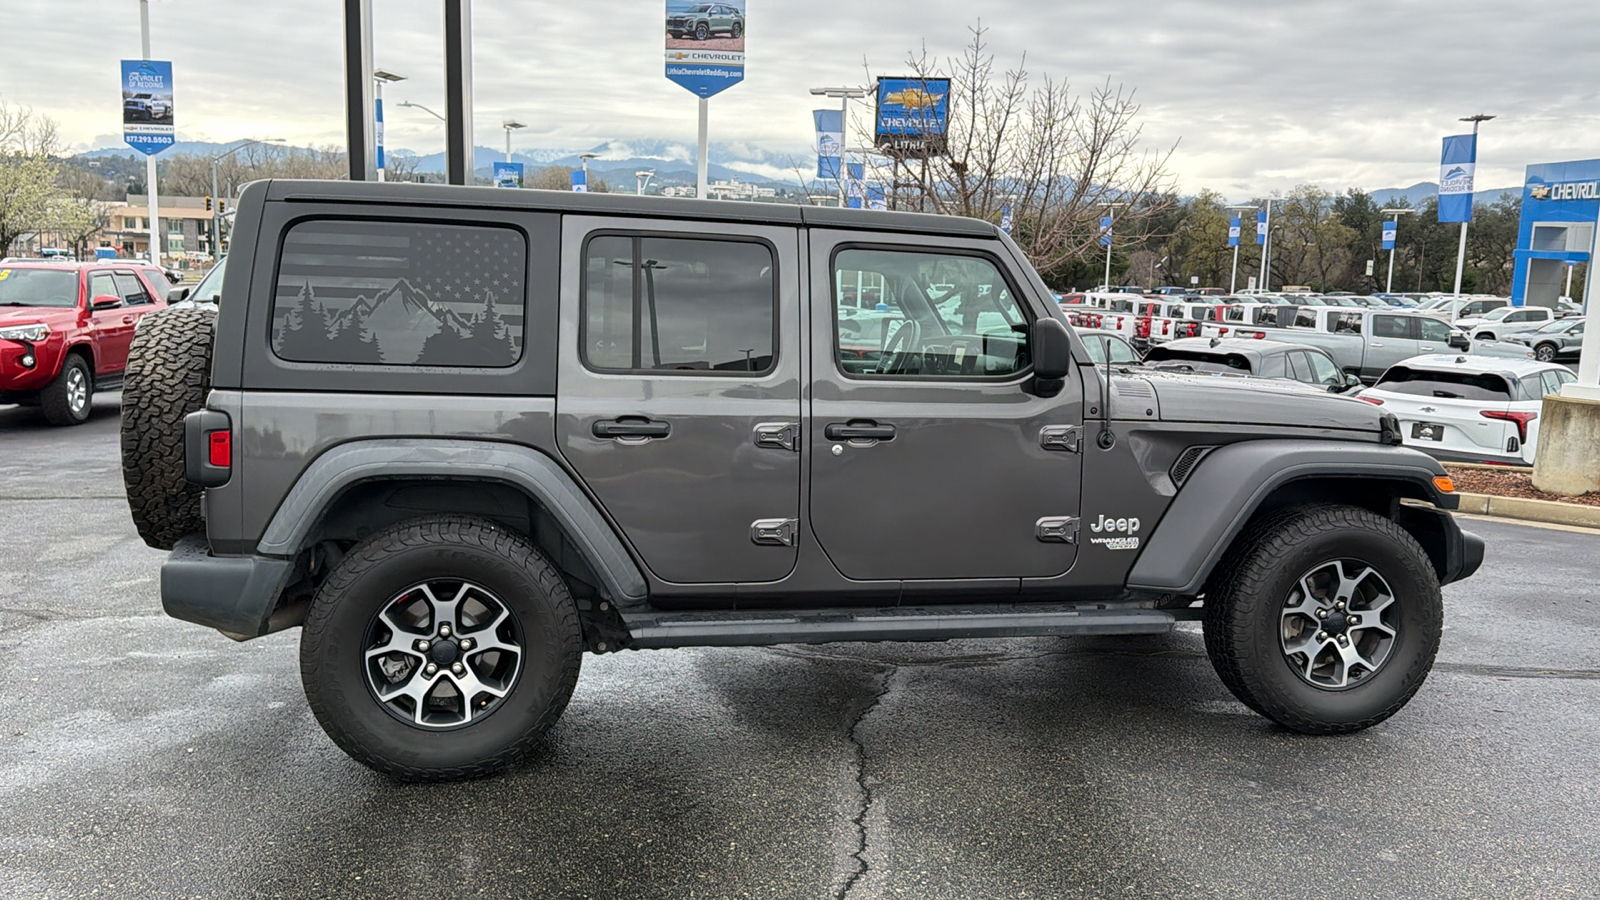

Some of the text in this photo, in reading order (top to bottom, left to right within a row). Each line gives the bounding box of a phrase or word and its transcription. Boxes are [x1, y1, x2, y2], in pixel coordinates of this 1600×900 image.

[692, 53, 742, 61] CHEVROLET
[667, 67, 742, 78] LithiaChevroletRedding.com
[881, 117, 942, 127] CHEVROLET
[1090, 514, 1140, 535] Jeep
